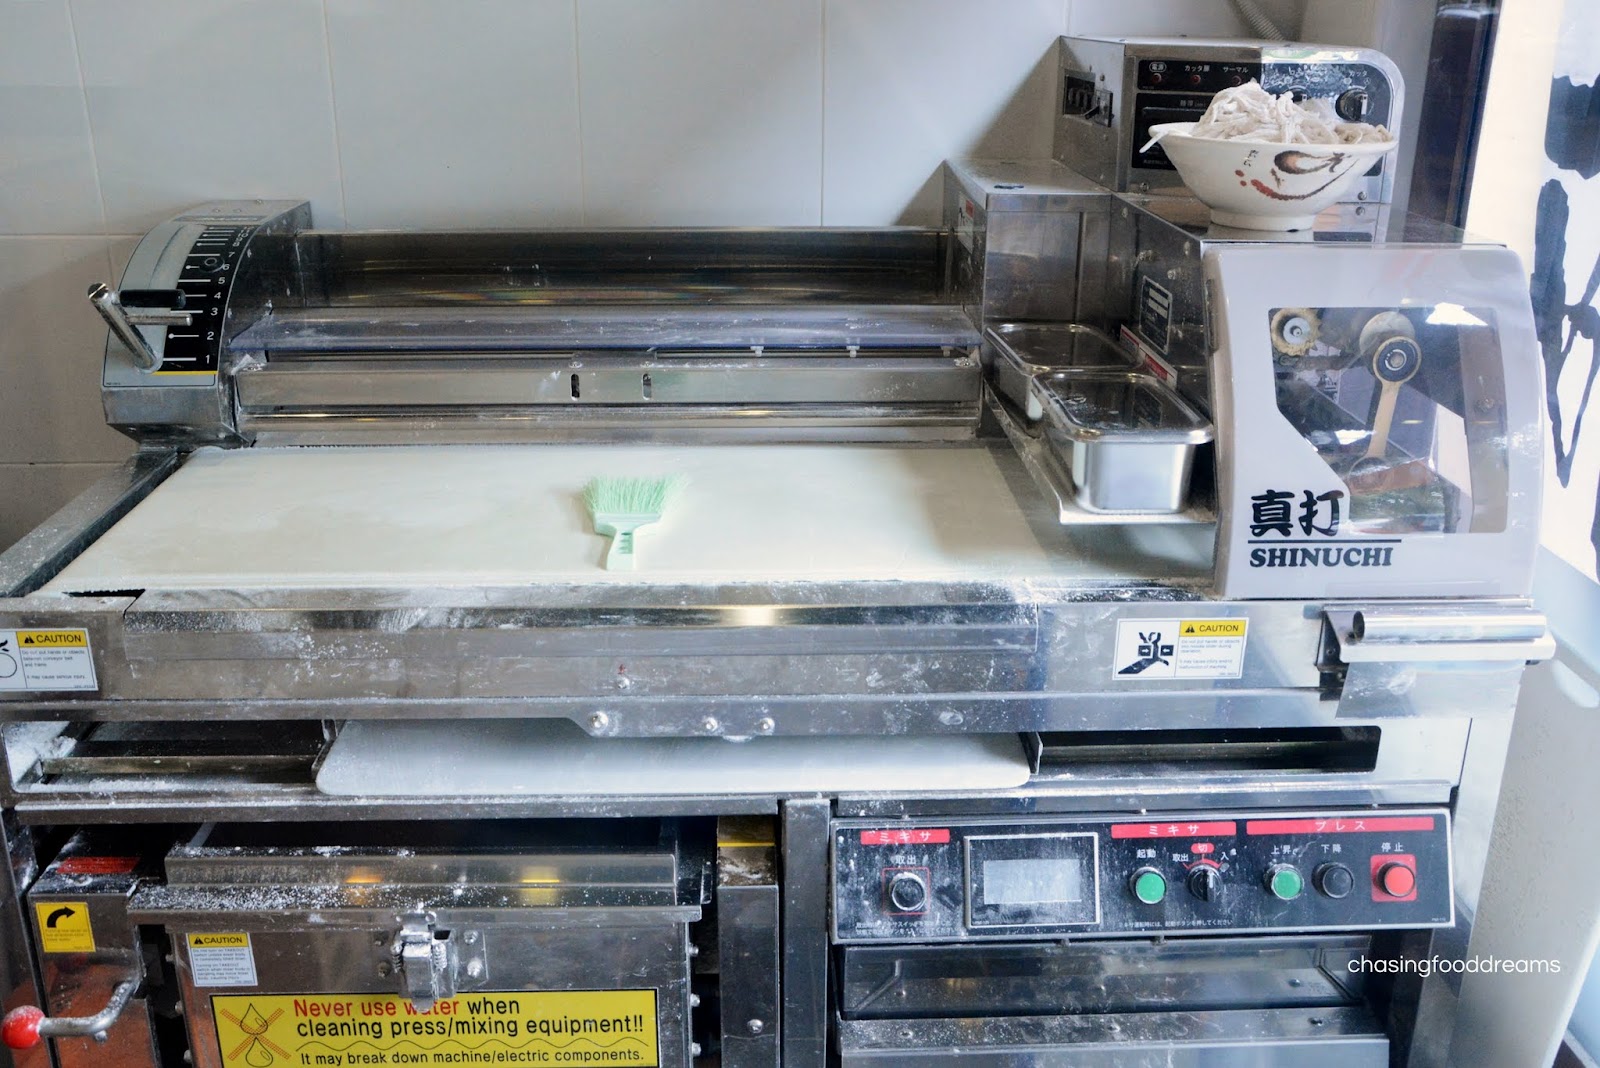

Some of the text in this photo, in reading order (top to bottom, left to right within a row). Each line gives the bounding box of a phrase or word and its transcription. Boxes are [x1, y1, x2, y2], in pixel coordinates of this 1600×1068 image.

[222, 263, 231, 271] 6
[217, 277, 226, 285] 5
[213, 291, 222, 300] 4
[210, 307, 219, 317] 3
[206, 331, 215, 341] 2
[205, 354, 211, 364] 1
[1250, 489, 1345, 537] 真打
[1250, 547, 1394, 568] SHINUCHI
[1199, 624, 1240, 633] CAUTION
[36, 634, 82, 644] CAUTION
[1149, 824, 1199, 836] ミキサ
[1315, 820, 1366, 832] プレス
[879, 831, 931, 843] ミキサ
[1137, 843, 1229, 862] 起動 取出 切 入
[1271, 842, 1404, 855] 上昇 下降 停止
[895, 855, 917, 865] 取出
[203, 936, 243, 944] CAUTION
[293, 997, 520, 1017] Never use wter when
[297, 1014, 644, 1039] cleaning press/mixing equipment!!
[301, 1049, 645, 1067] It may break down machine/electric components.
